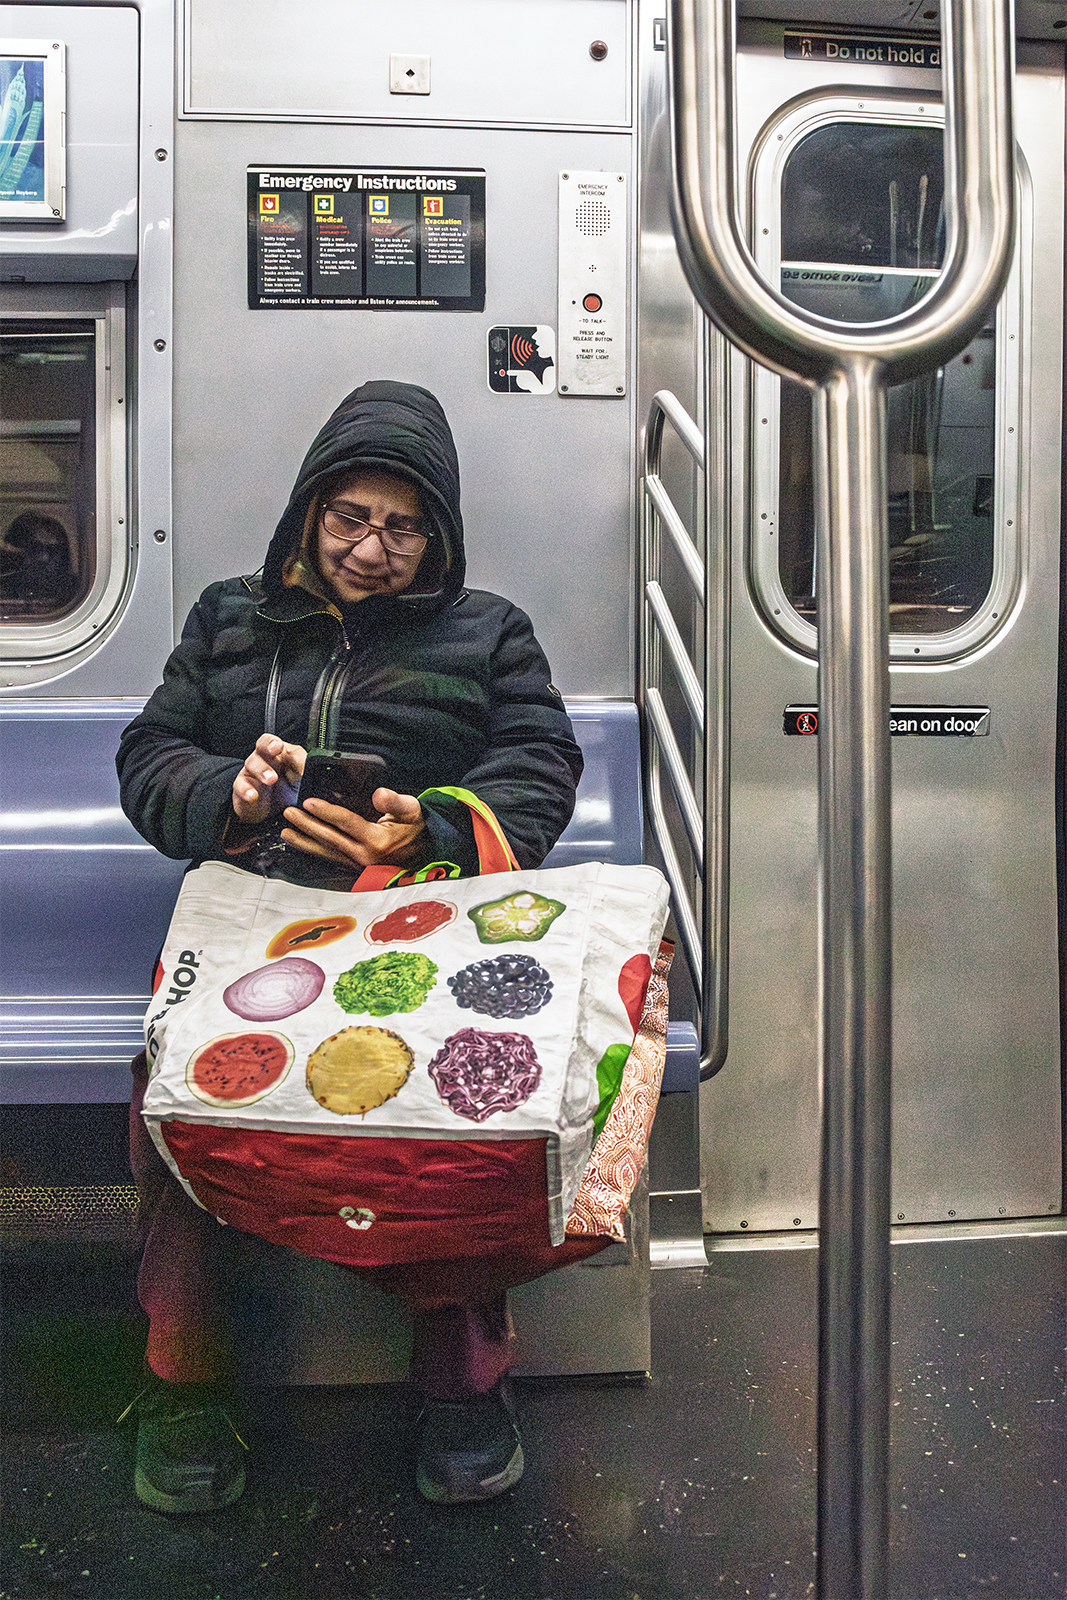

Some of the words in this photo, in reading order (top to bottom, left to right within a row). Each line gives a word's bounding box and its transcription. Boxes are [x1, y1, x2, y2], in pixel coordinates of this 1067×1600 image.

[826, 43, 850, 59] Do
[855, 46, 883, 61] not
[887, 46, 925, 64] hold
[259, 173, 353, 192] Emergency
[357, 175, 457, 191] Instructions
[890, 719, 917, 732] ean
[921, 720, 941, 732] on
